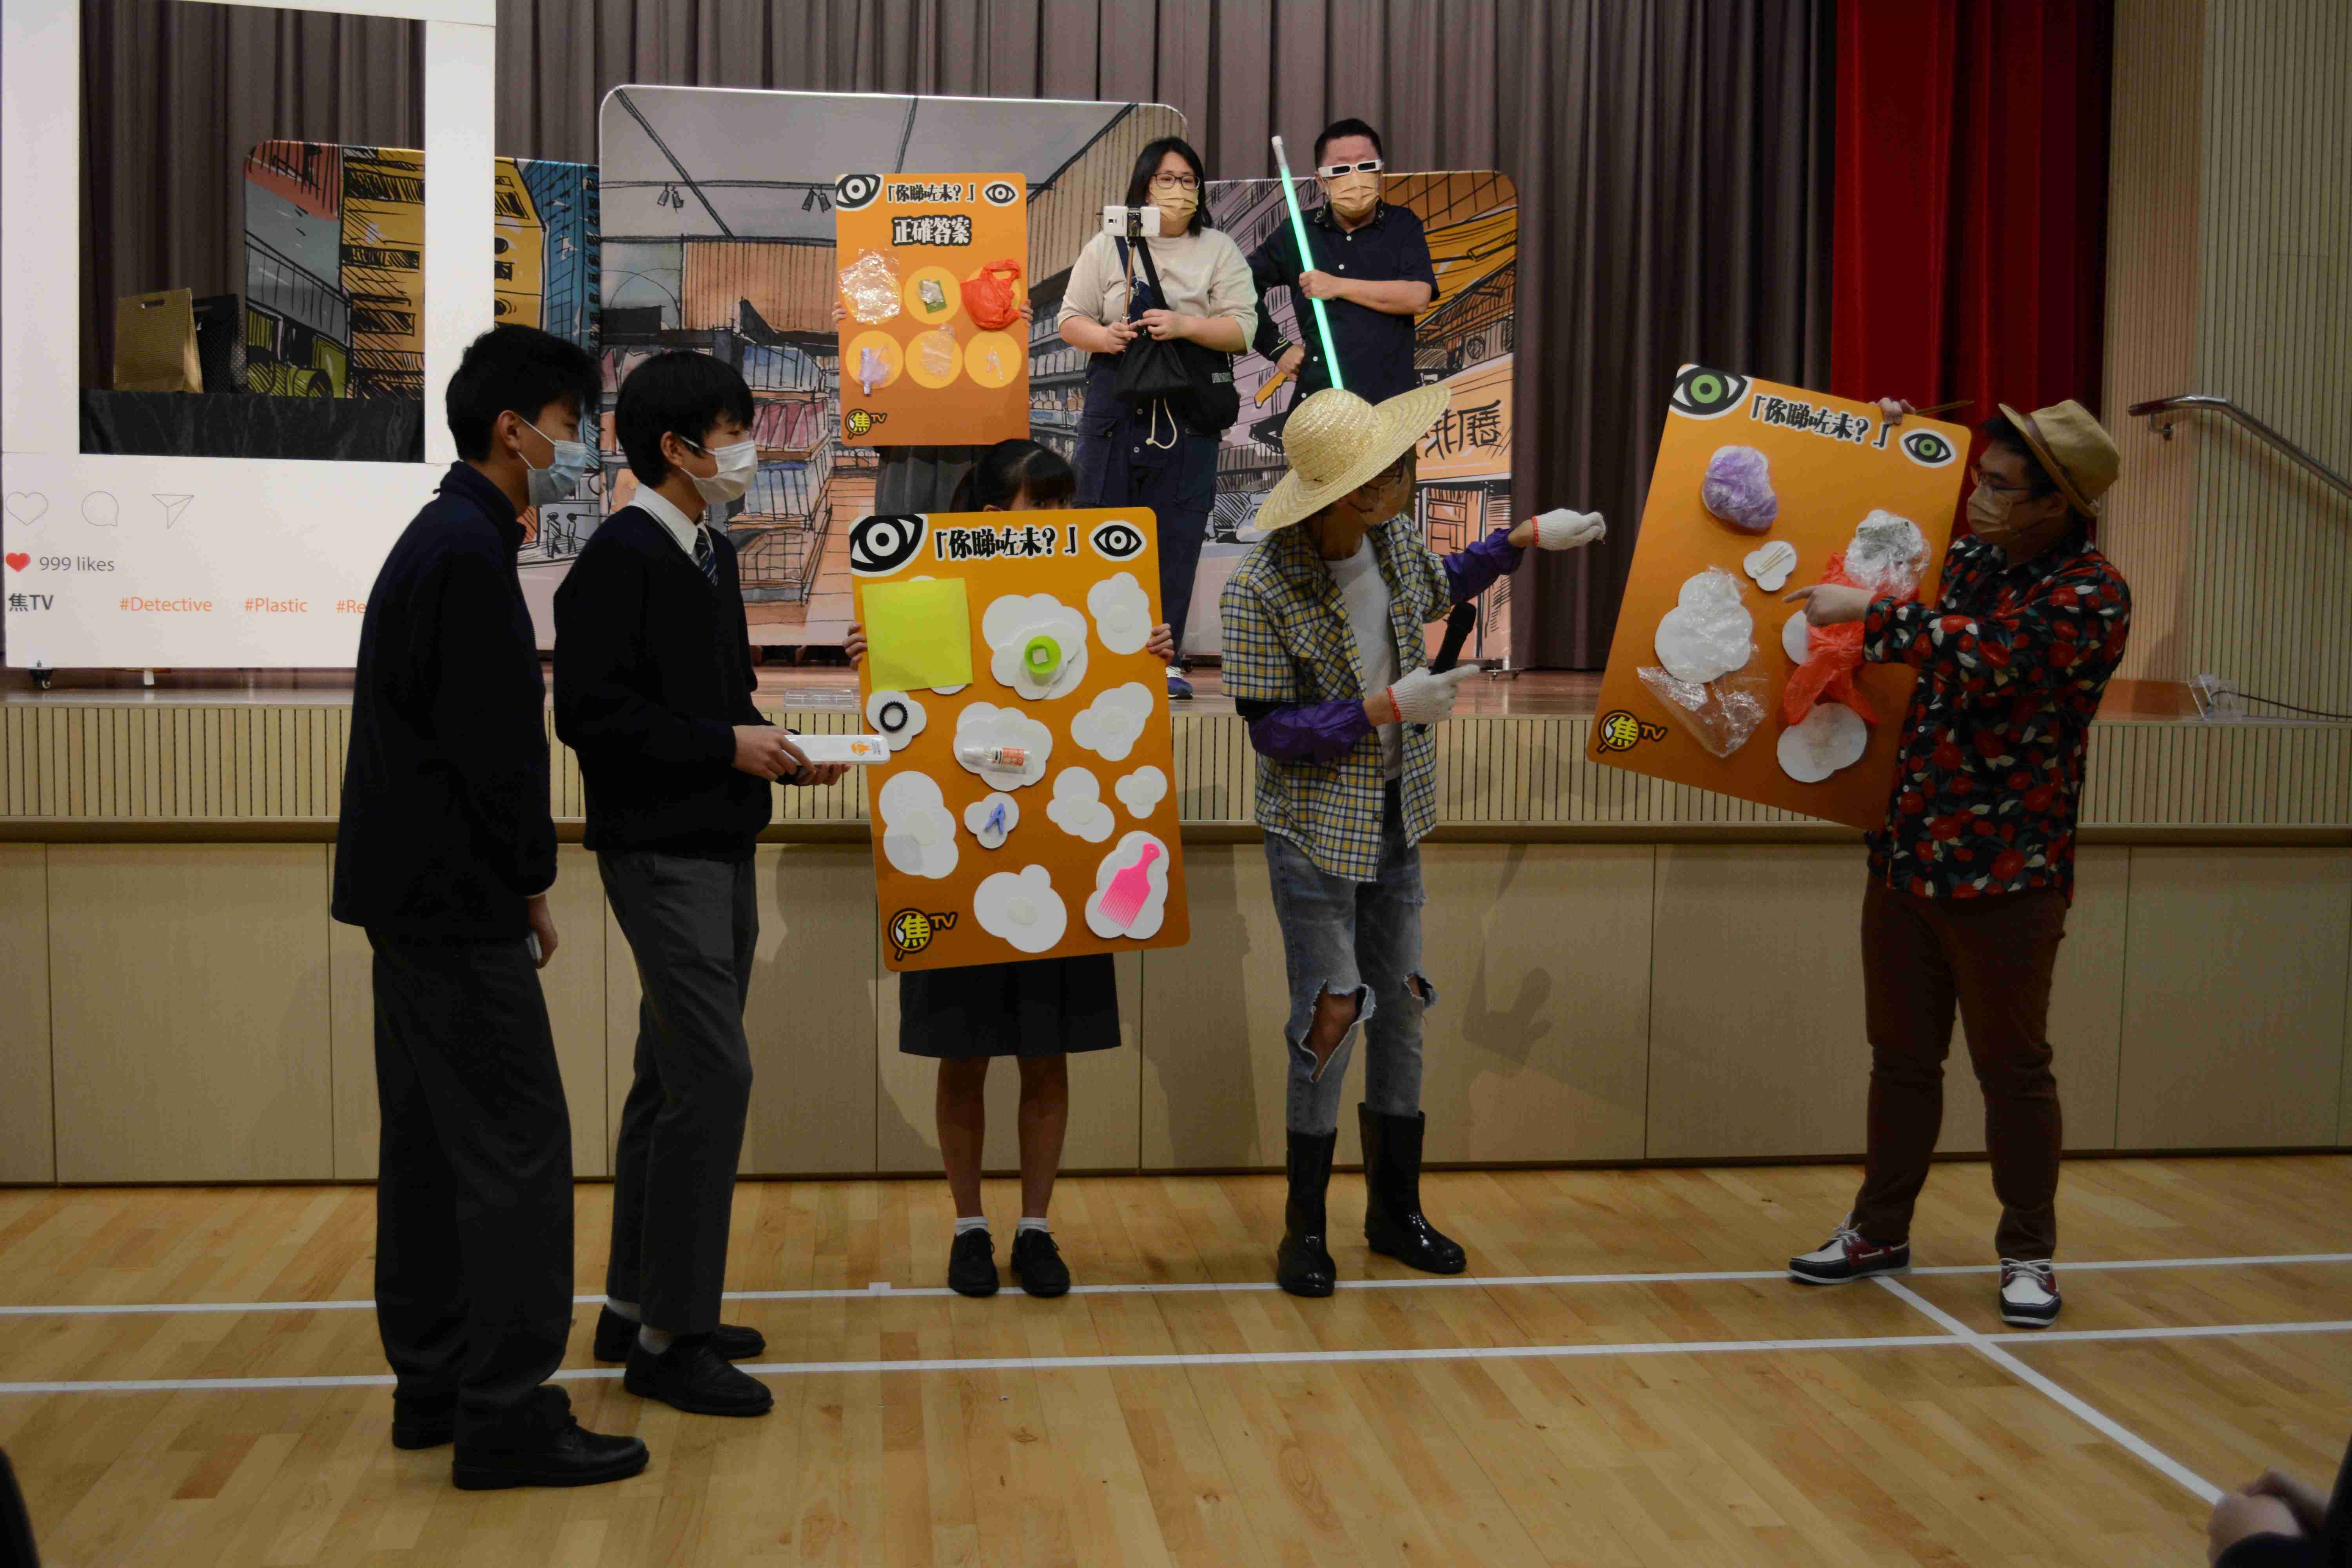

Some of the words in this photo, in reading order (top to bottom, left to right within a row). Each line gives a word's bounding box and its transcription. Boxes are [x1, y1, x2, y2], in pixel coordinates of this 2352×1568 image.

[894, 216, 973, 245] 正確答案
[40, 557, 71, 570] 999
[77, 556, 115, 571] likes
[8, 593, 54, 612] 焦TV
[120, 597, 213, 612] #Detective
[245, 598, 308, 613] #Plastic
[336, 599, 367, 614] #Re
